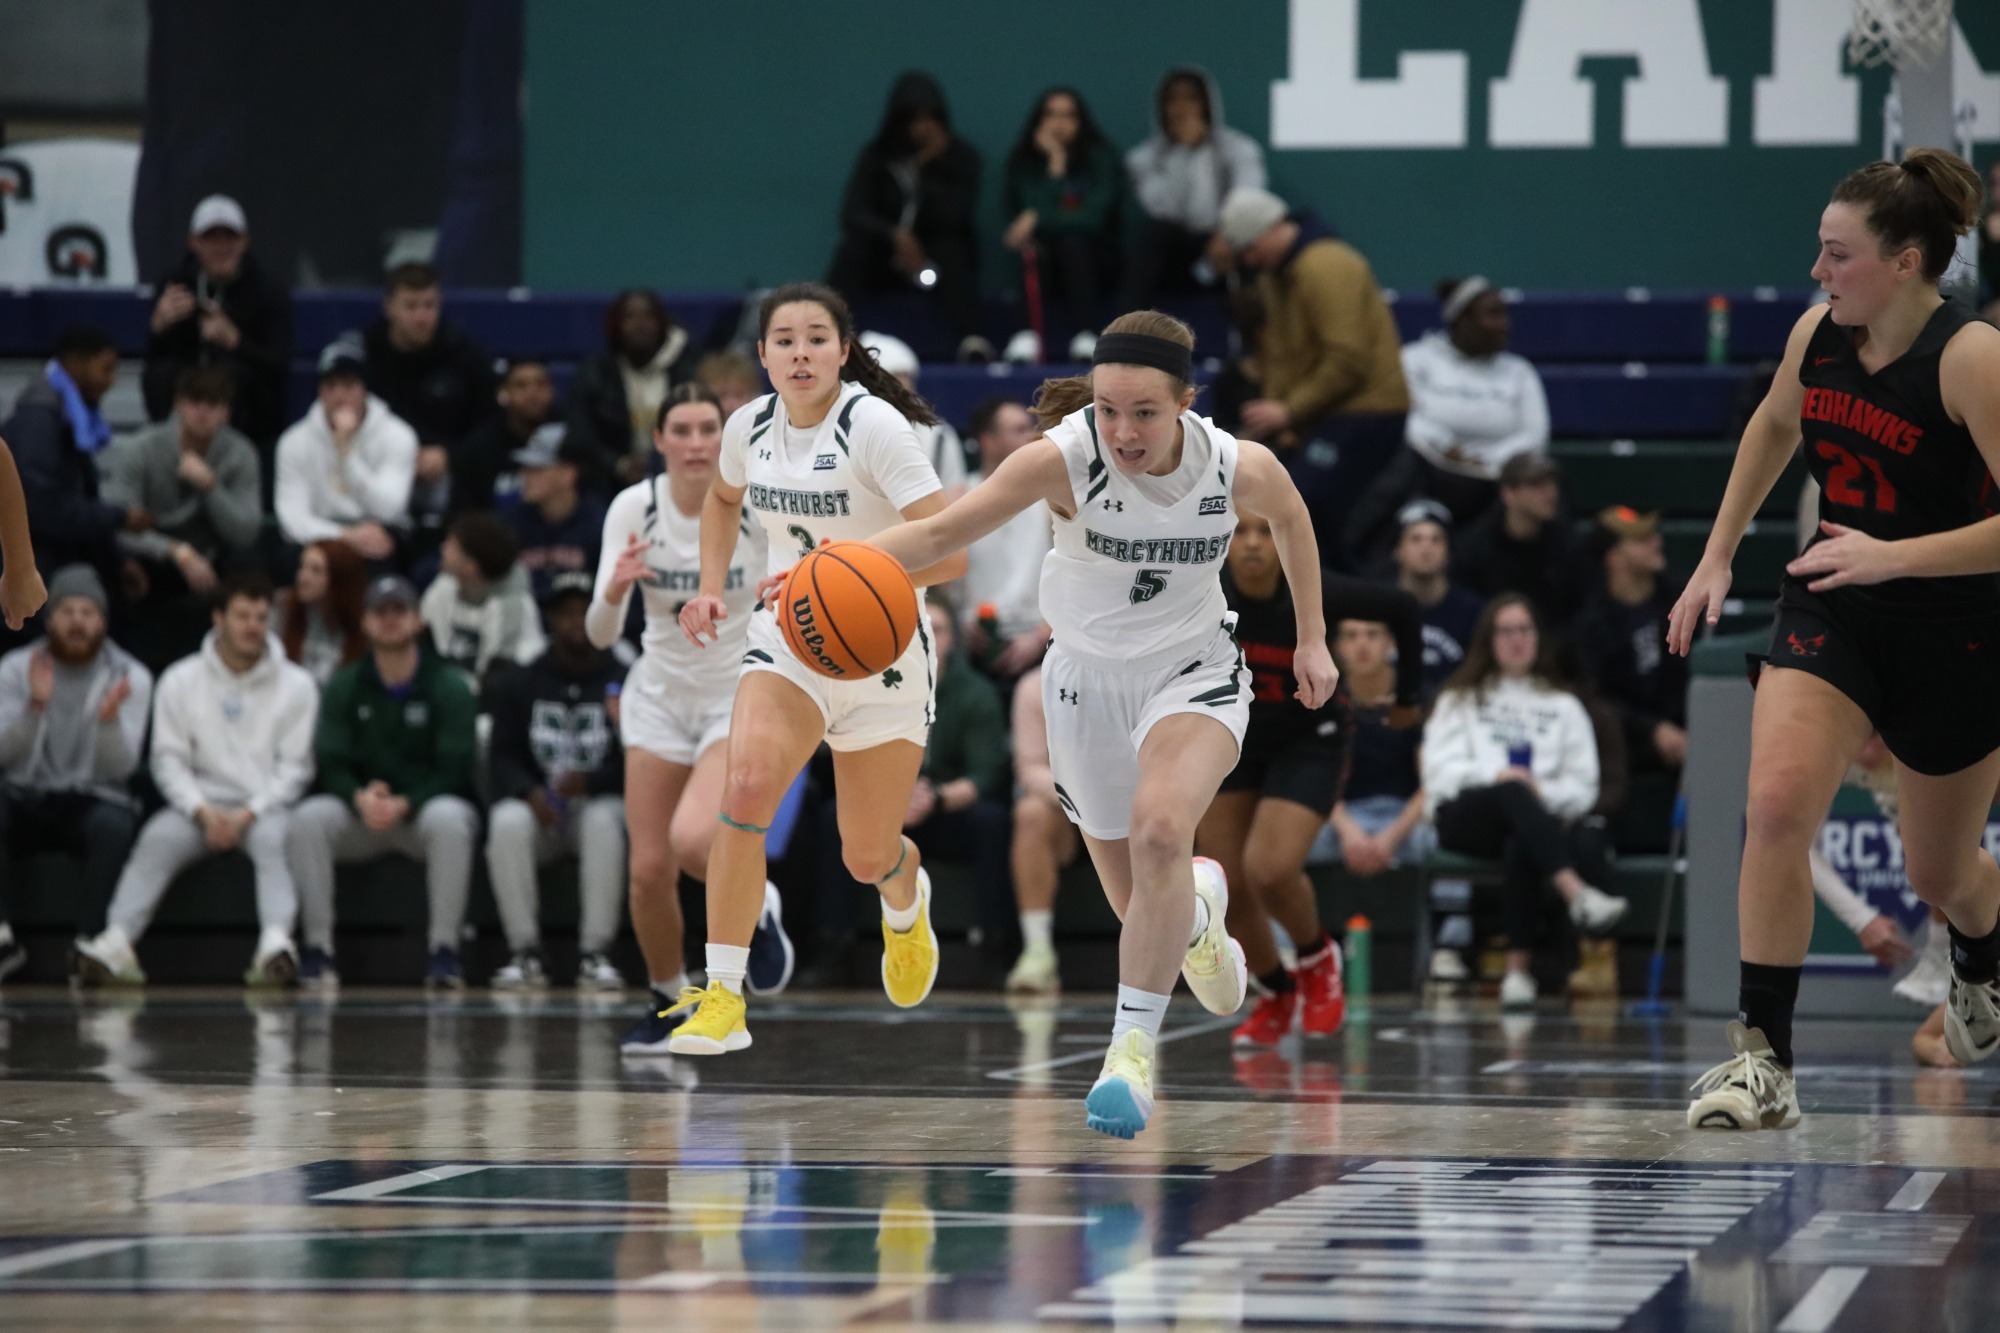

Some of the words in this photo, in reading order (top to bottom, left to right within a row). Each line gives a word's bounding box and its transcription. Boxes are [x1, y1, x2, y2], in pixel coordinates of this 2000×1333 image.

[1815, 439, 1897, 513] 21
[1199, 499, 1227, 513] PSAC
[1085, 528, 1233, 565] MERCYHURST
[1129, 569, 1172, 605] 5
[793, 594, 845, 675] Wilson
